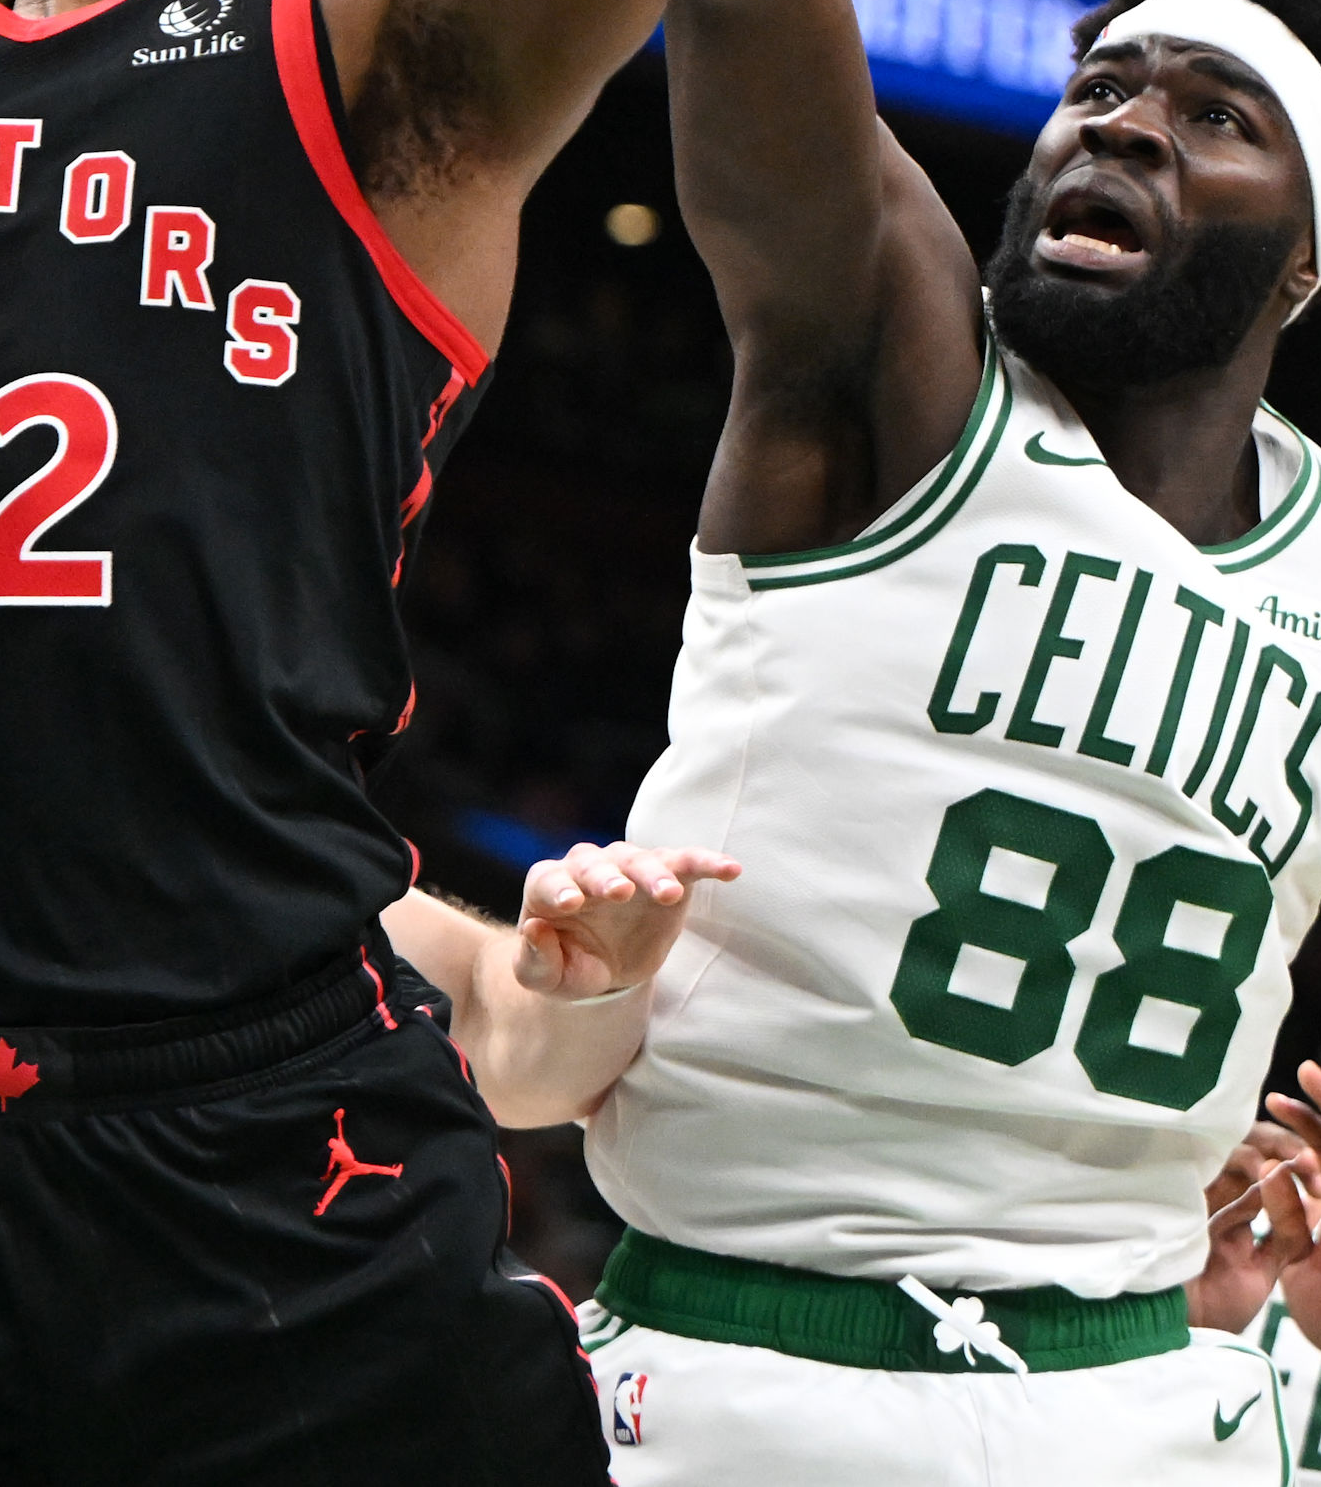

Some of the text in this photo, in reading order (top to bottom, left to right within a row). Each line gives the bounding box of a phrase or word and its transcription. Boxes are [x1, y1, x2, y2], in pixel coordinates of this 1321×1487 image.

[131, 30, 246, 66] Sun Life
[889, 787, 1274, 1112] 88
